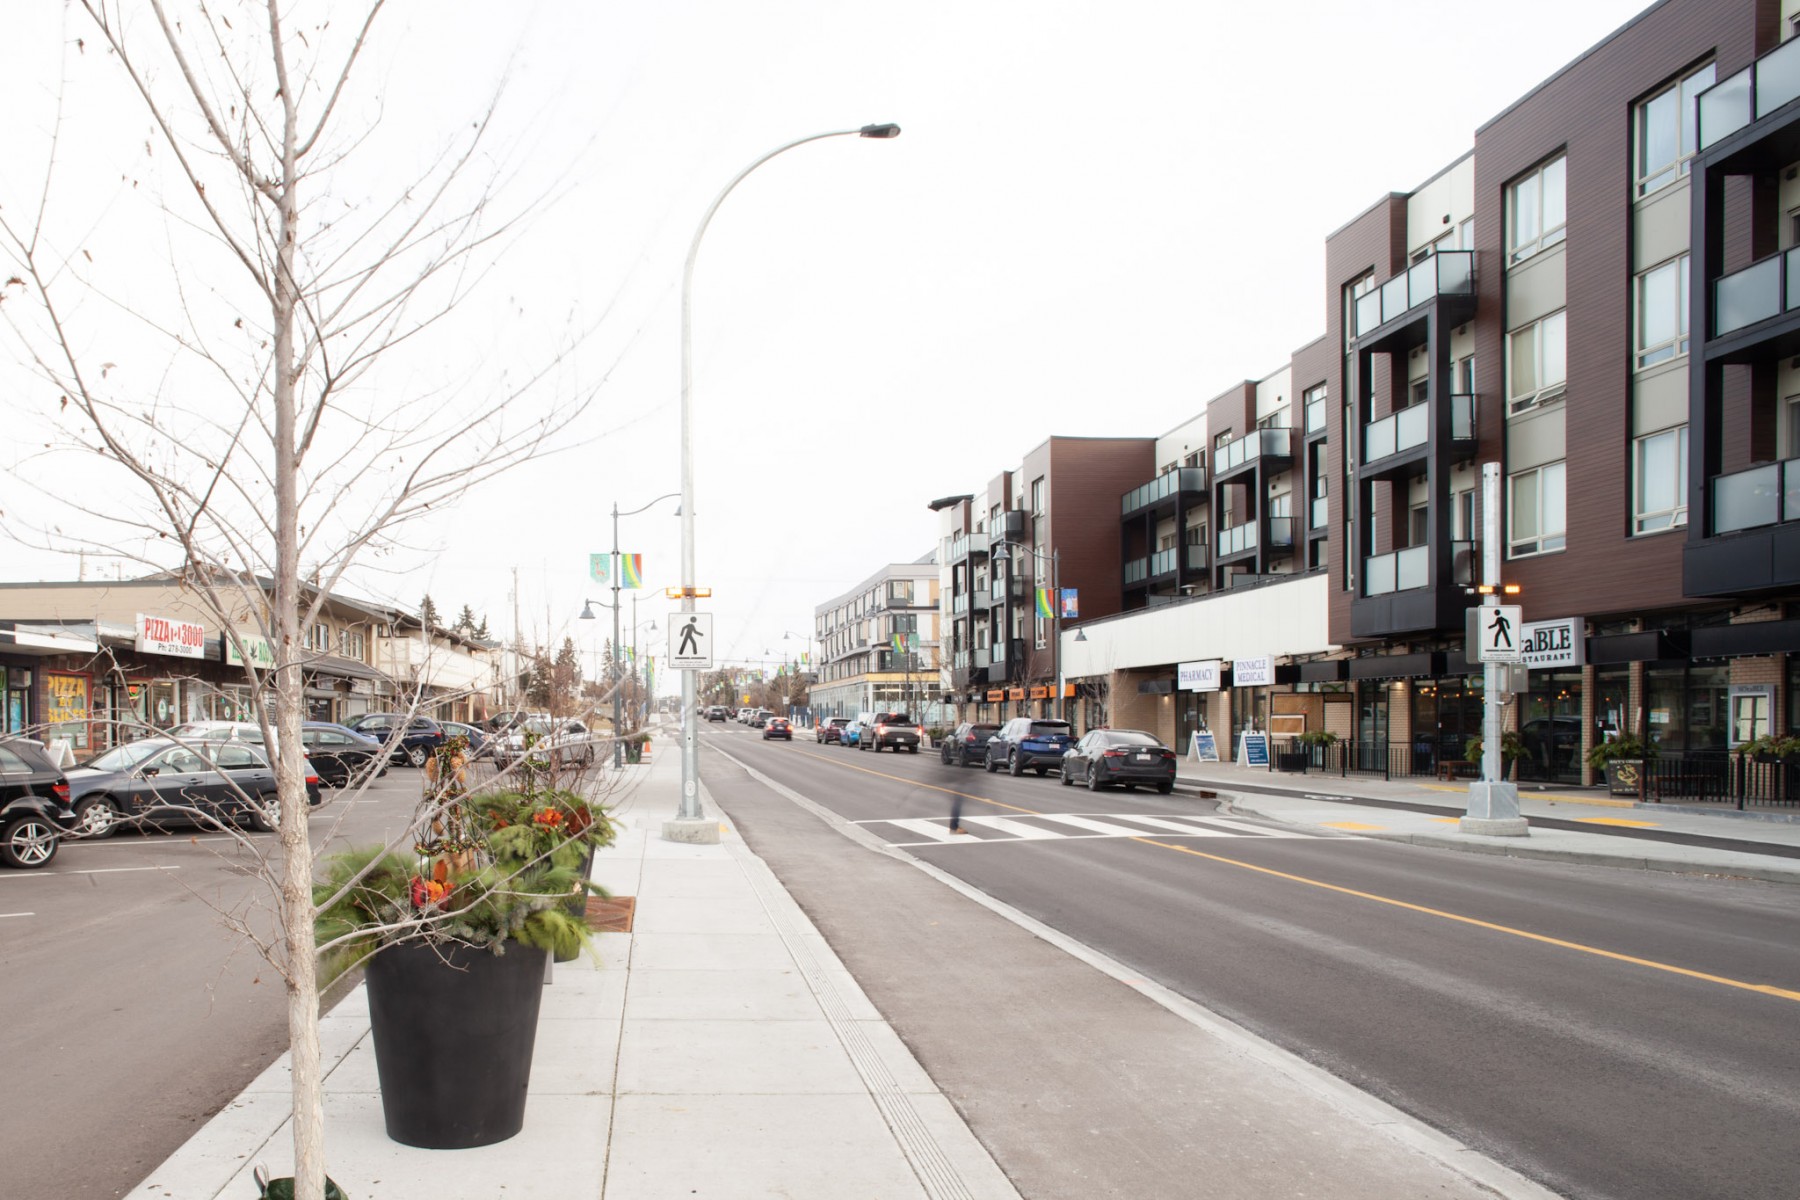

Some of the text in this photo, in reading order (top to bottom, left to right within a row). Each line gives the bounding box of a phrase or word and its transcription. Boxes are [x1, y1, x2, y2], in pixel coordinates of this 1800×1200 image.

[145, 618, 203, 647] PIZZA 3000
[1522, 653, 1571, 663] STAURANT
[1236, 659, 1267, 671] PINNACLE
[1180, 669, 1214, 682] PHARMACY
[1237, 671, 1265, 682] MEDICAL
[48, 676, 84, 697] PIZZA
